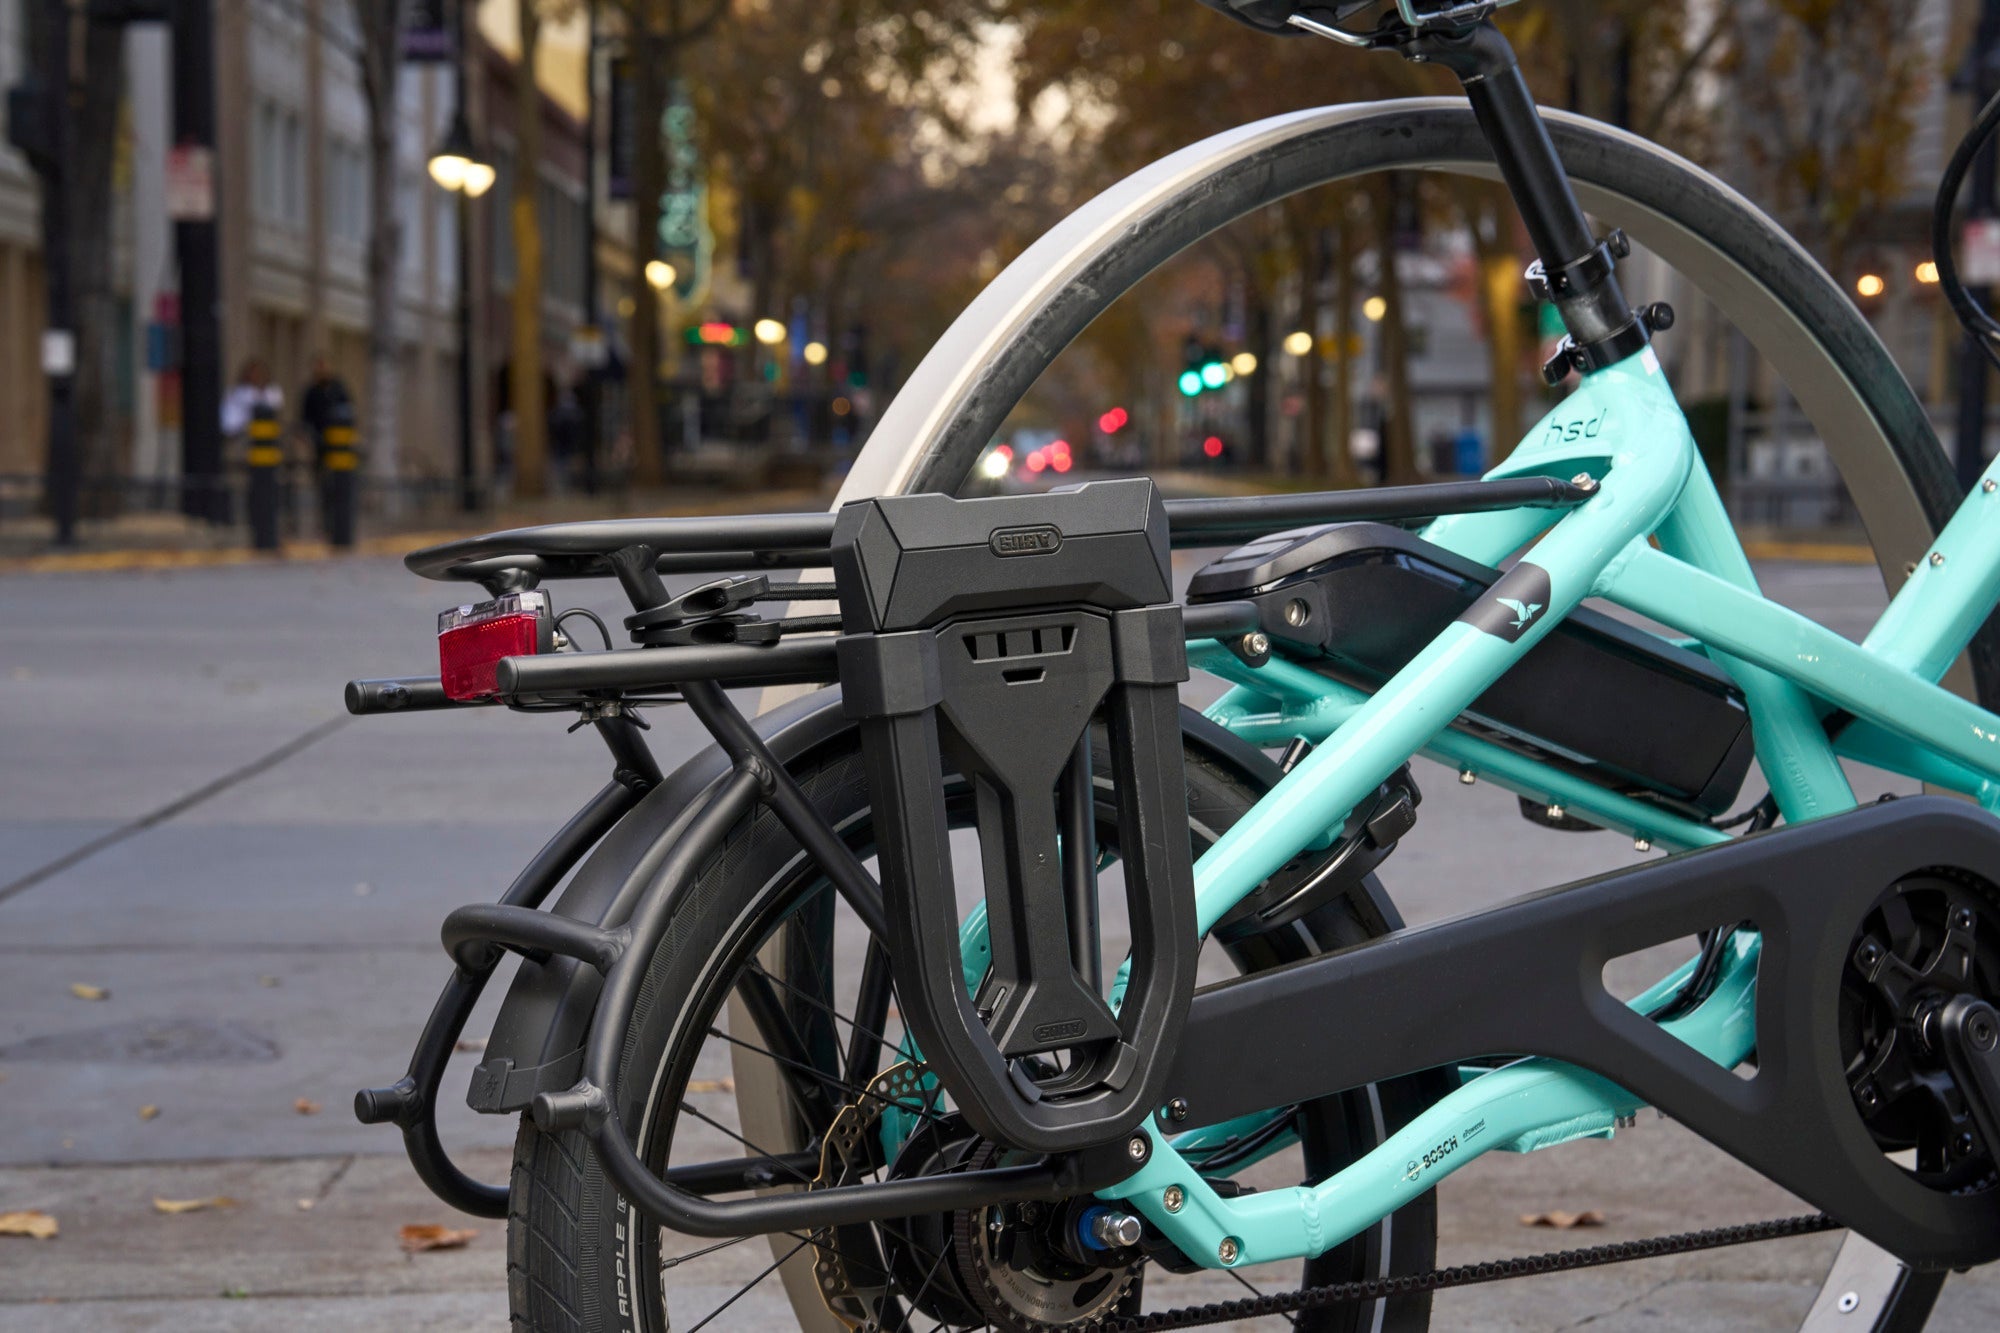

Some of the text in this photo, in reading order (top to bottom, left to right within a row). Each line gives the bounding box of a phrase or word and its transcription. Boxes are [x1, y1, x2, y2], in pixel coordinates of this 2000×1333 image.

[1543, 407, 1608, 447] hsd
[1000, 531, 1052, 551] ABUS
[1422, 1134, 1458, 1169] BOSCH
[615, 1222, 630, 1317] APPLE
[1006, 1277, 1026, 1298] DRIVE
[1025, 1294, 1055, 1310] CARBON
